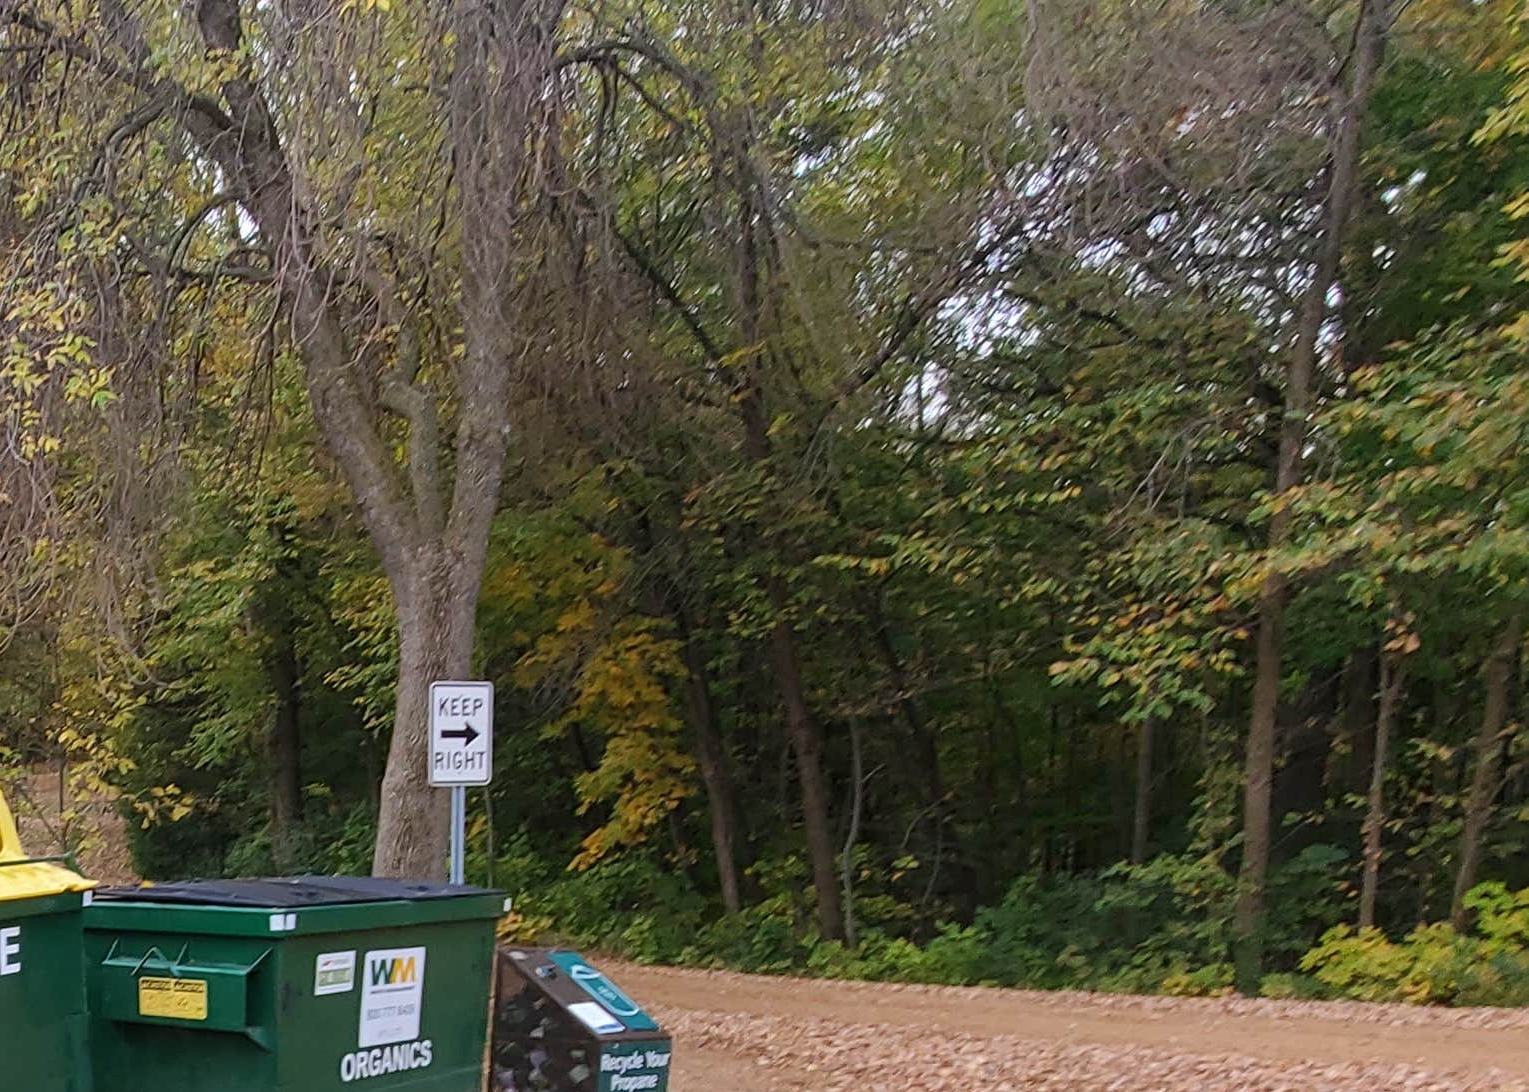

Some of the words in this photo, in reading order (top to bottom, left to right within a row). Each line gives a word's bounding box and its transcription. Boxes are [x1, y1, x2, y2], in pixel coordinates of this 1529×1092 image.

[438, 697, 483, 717] KEEP
[434, 750, 487, 771] RIGHT
[370, 956, 417, 986] WM
[340, 1040, 433, 1082] ORGANICS
[600, 1050, 645, 1075] Recycle
[645, 1050, 671, 1069] Your
